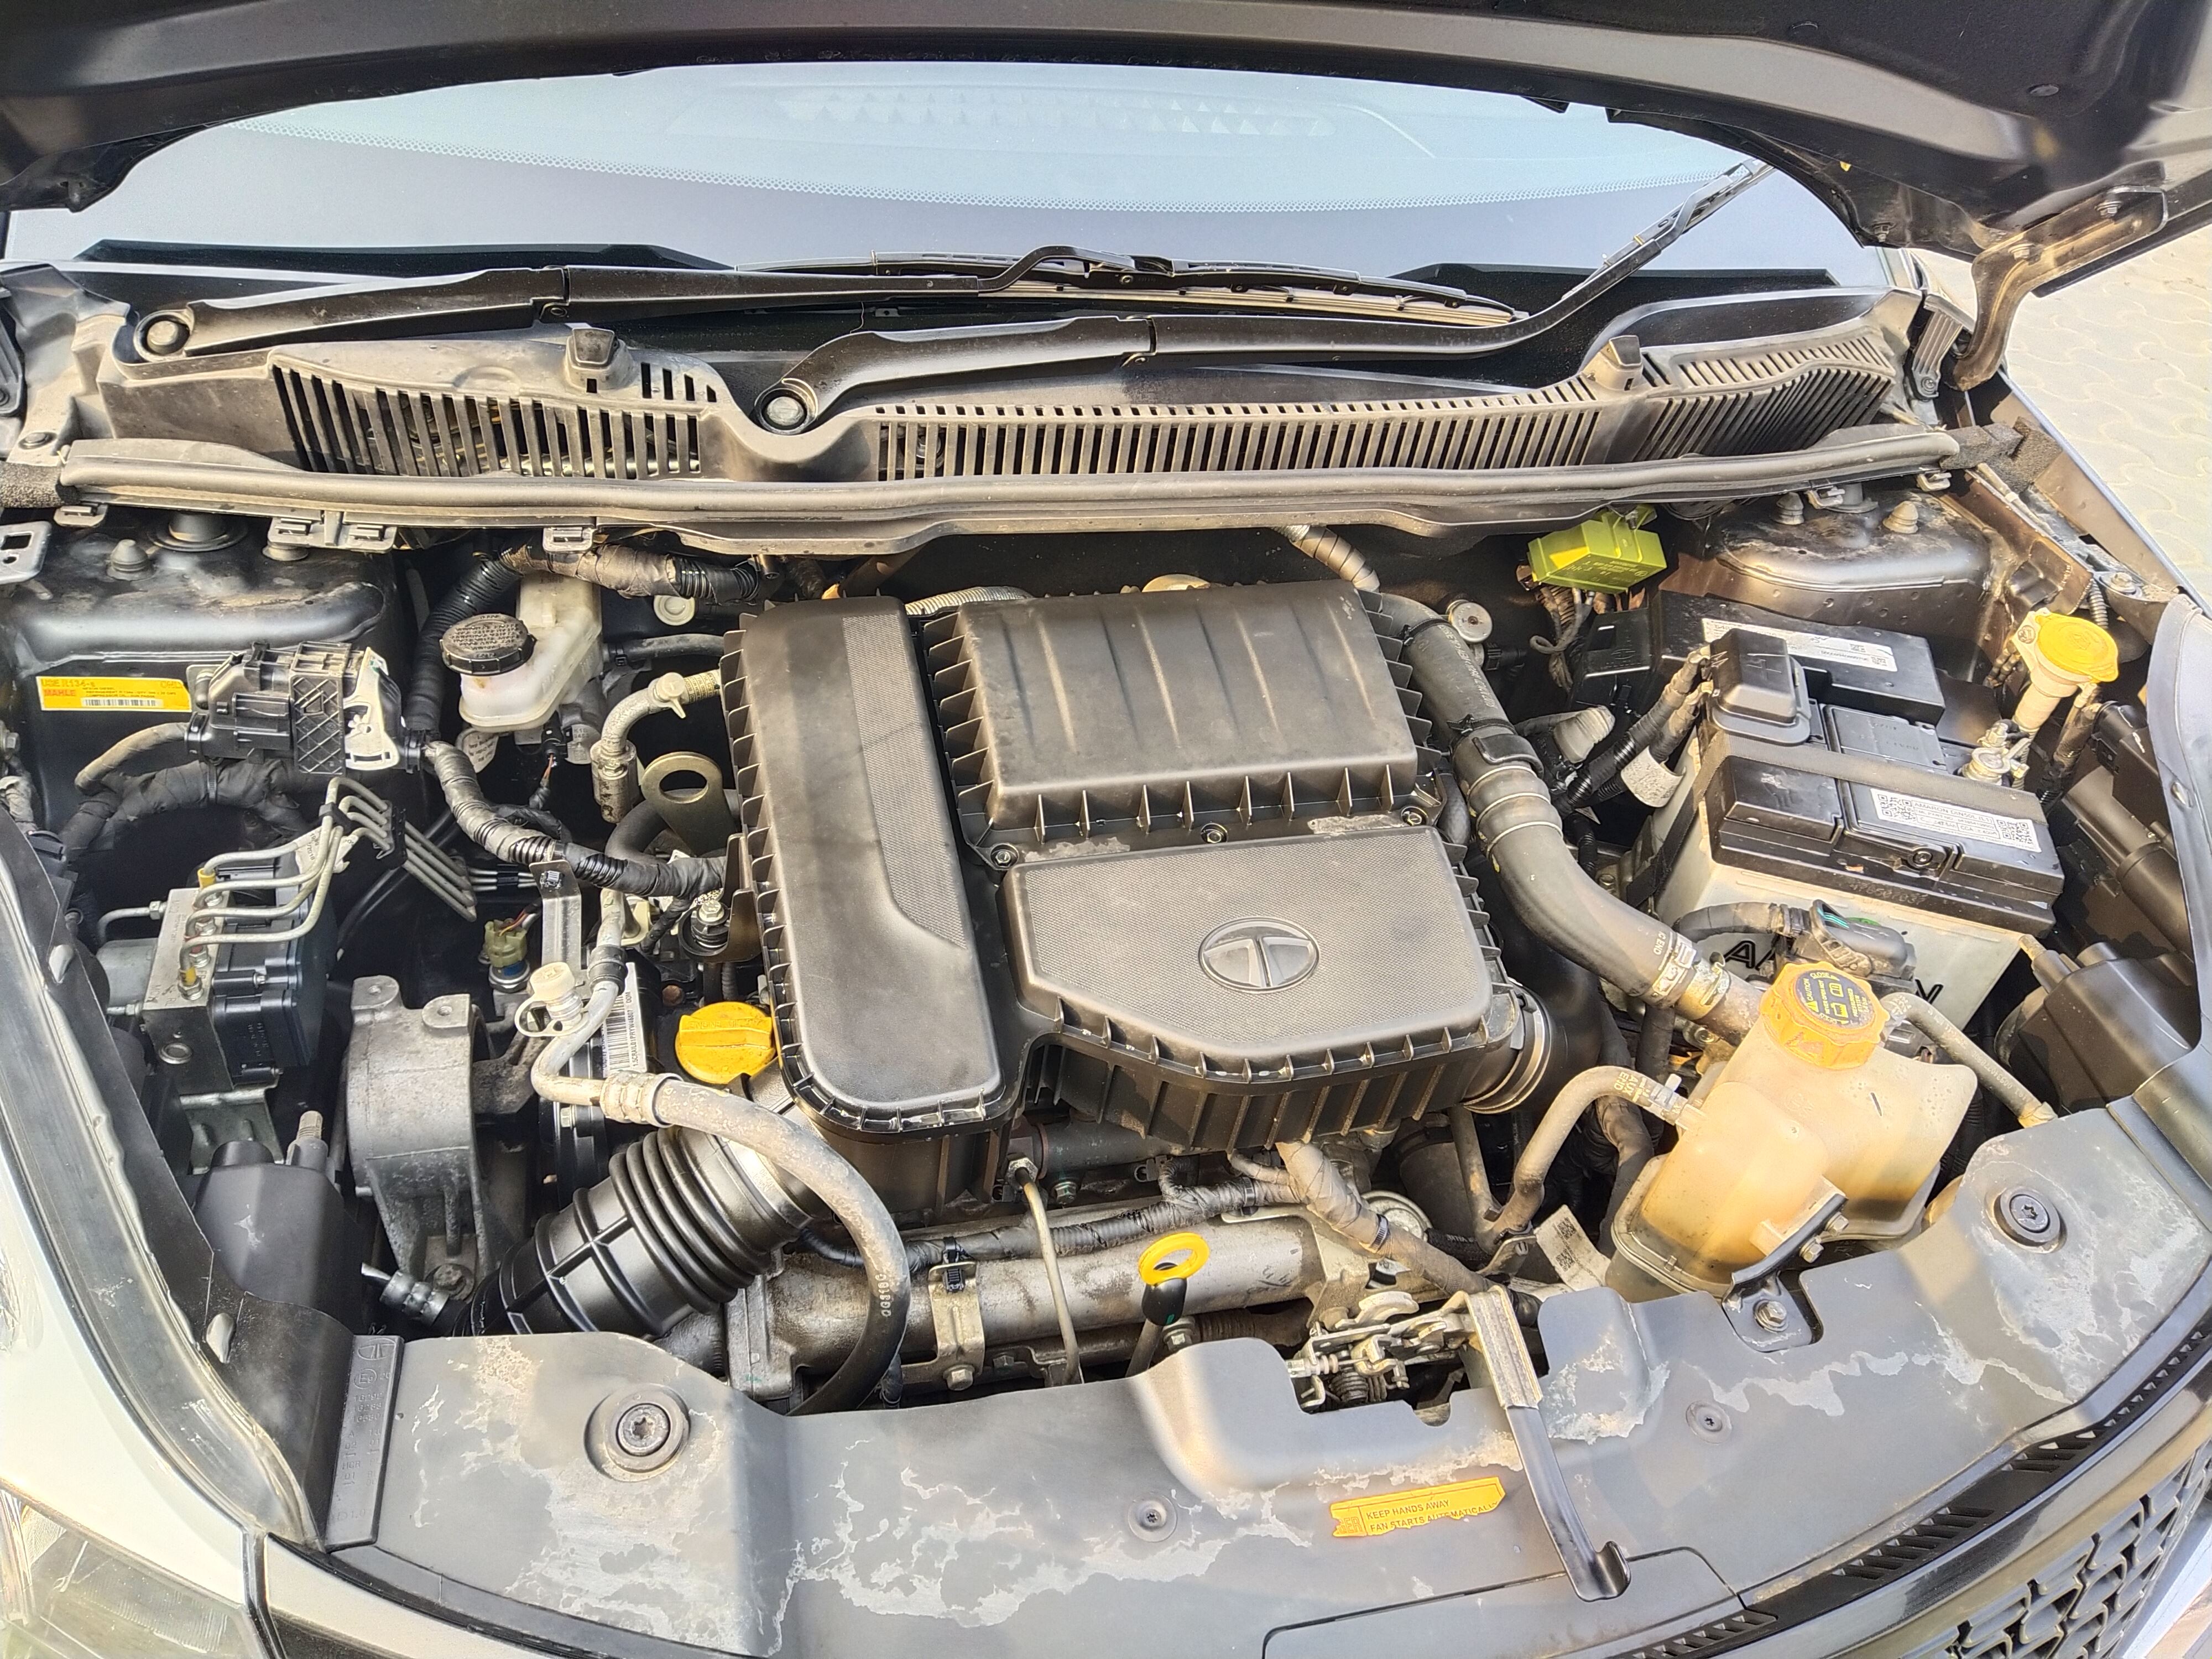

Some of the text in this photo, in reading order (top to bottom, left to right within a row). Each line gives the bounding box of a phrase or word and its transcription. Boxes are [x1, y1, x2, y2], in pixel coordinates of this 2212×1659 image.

[1914, 802, 1949, 813] AMARON
[1653, 938, 1666, 956] END
[1810, 972, 1830, 980] CLOSE
[1803, 978, 1814, 1001] CAUTION
[1614, 1071, 1630, 1091] END
[1621, 1074, 1639, 1095] AUX
[1366, 1510, 1390, 1520] KEEP
[1392, 1504, 1424, 1516] HANDS
[1425, 1499, 1449, 1510] AWAY
[1370, 1522, 1389, 1532] FAN
[1390, 1516, 1425, 1530] STARTS
